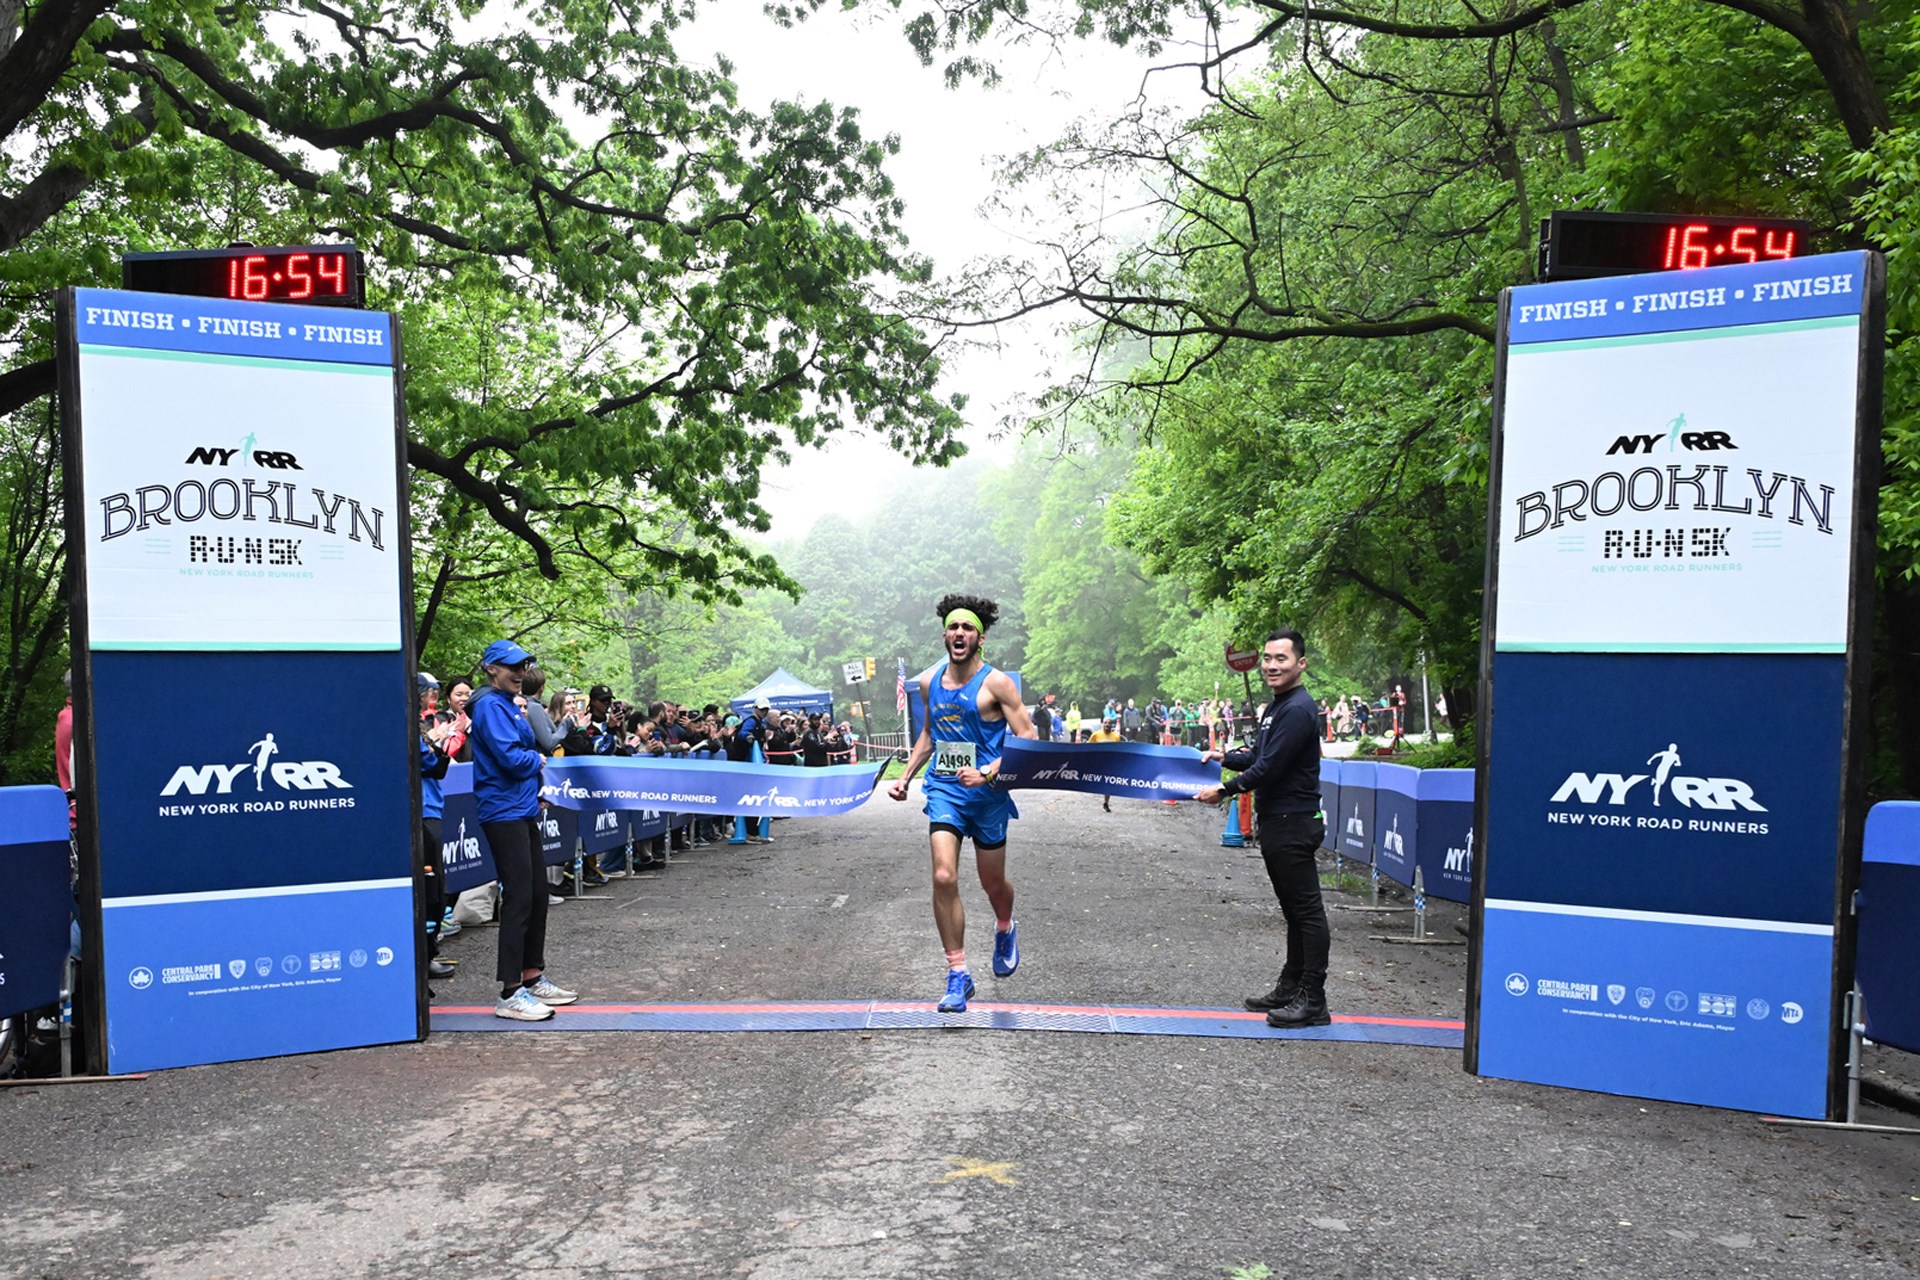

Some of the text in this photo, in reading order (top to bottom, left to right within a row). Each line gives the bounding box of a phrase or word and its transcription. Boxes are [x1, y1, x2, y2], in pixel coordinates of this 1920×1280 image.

[1519, 275, 1852, 323] FINISH FINISH FINISH
[86, 308, 383, 346] FINISH FINISH FINISH
[1515, 465, 1835, 543] BROOKLYN
[100, 478, 384, 550] BROOKLYN
[206, 569, 234, 577] YORK
[236, 570, 266, 578] ROAD
[267, 571, 315, 579] RUNNERS
[1592, 563, 1743, 573] NEW YORK ROAD RUNNERS
[938, 754, 971, 768] A1498
[159, 761, 355, 796] NYRR
[1082, 774, 1102, 783] NEW
[1104, 775, 1129, 786] YORK
[1131, 779, 1159, 789] ROAD
[613, 791, 639, 799] YORK
[641, 792, 670, 801] ROAD
[671, 794, 718, 804] RUNNERS
[1550, 773, 1769, 812] NYRR
[159, 798, 356, 817] NEW YORK ROAD RUNNERS
[804, 799, 827, 807] NEW
[829, 796, 854, 805] YORK
[1547, 812, 1769, 835] NEW YORK ROAD RUNNERS
[162, 964, 215, 976] CENTRAL PARK
[162, 973, 215, 984] CONSERVANCY
[1537, 979, 1591, 992] CENTRAL PARK
[1537, 988, 1591, 1000] CONSERVANCY
